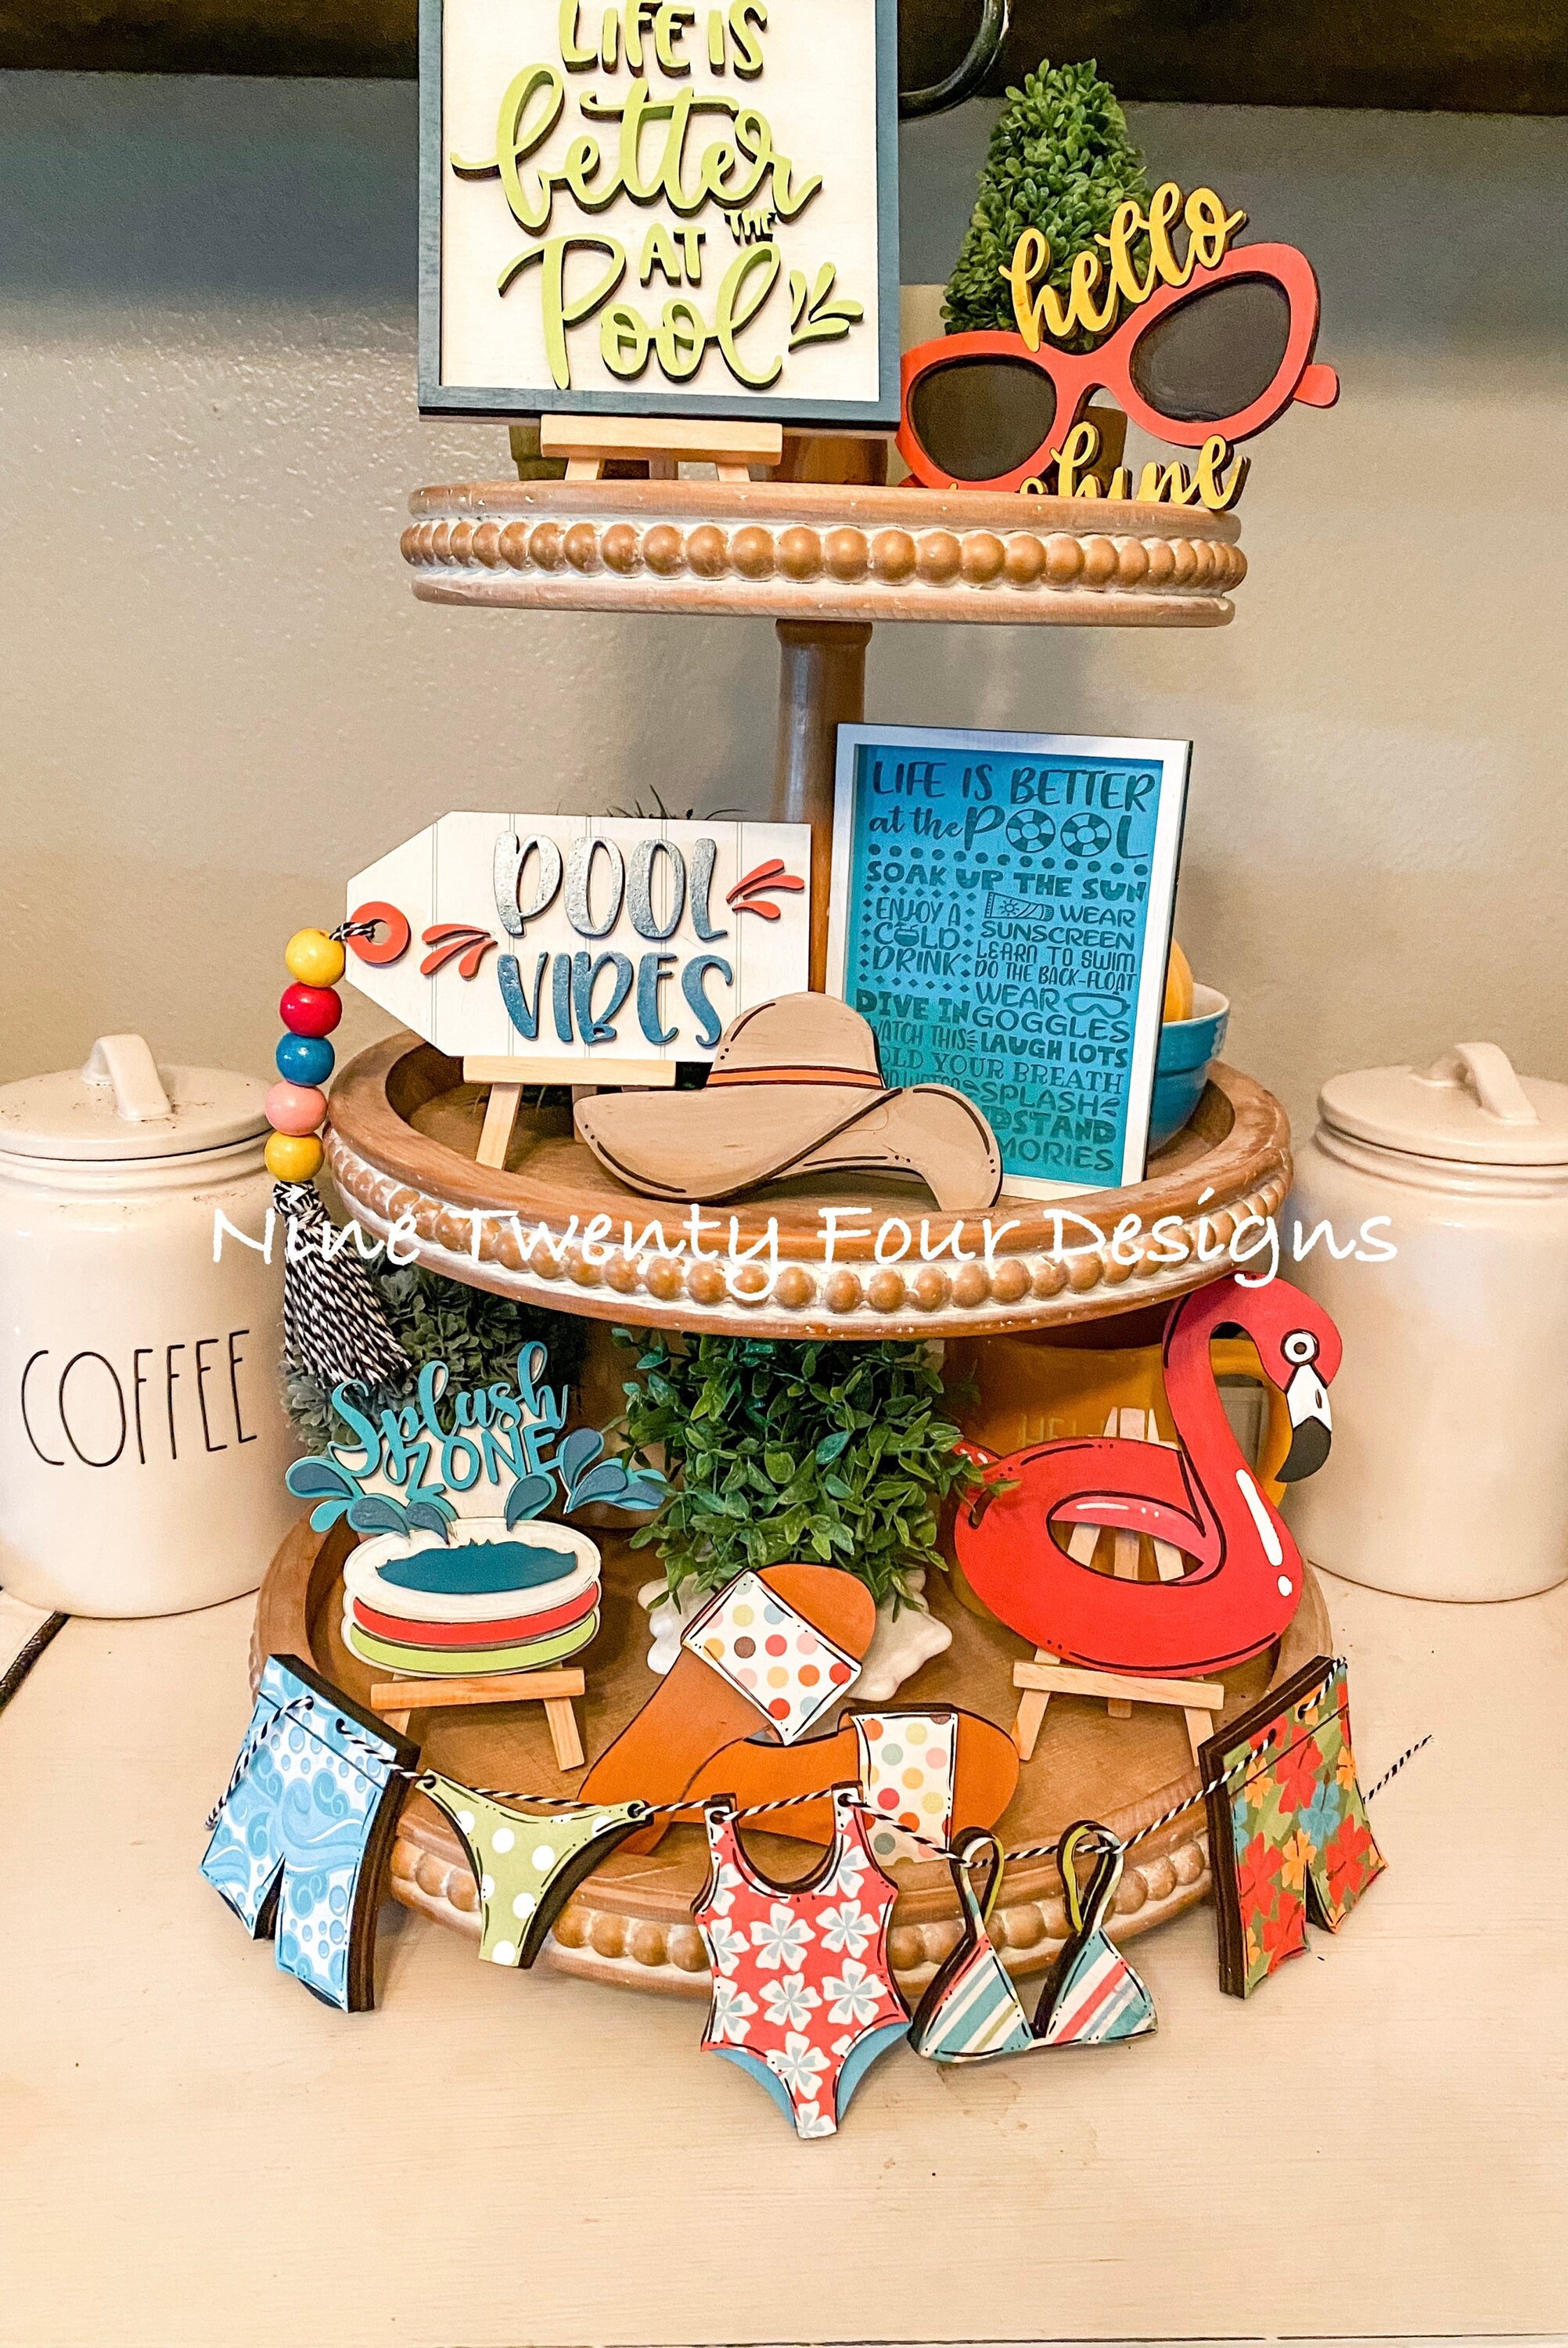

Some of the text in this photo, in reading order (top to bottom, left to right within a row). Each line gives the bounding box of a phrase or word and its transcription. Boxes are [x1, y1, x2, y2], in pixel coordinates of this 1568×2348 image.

[559, 0, 768, 81] LIFE IS
[450, 63, 823, 235] better
[640, 207, 776, 286] AT THE
[998, 182, 1249, 352] hello
[497, 233, 783, 391] Pool
[872, 760, 1156, 812] LIFE IS BETTER
[869, 805, 1149, 859] at the POOL
[493, 830, 728, 942] POOL
[866, 860, 1147, 903] SOAK UP THE SUN
[876, 896, 962, 927] ENJOY A
[1059, 904, 1136, 929] WEAR
[976, 939, 1135, 973] LEARN TO SWIM
[980, 920, 1135, 952] SUNSCREEN
[872, 945, 962, 977] DRINK
[974, 959, 1138, 992] DO THE BACK-FLOAT
[497, 950, 735, 1049] VIBES
[856, 987, 971, 1025] DIVE IN
[975, 981, 1061, 1014] WEAR
[930, 1024, 967, 1051] THIS
[972, 1006, 1131, 1044] GOGGLES
[880, 1045, 924, 1070] OLD
[930, 1051, 1005, 1080] YOUR
[1012, 1061, 1125, 1095] BREATH
[980, 1031, 1129, 1069] LAUGH LOTS
[979, 1081, 1099, 1118] SPLASH
[982, 1104, 1117, 1145] DSTAND
[998, 1136, 1115, 1172] MORIES
[20, 1328, 258, 1468] COFFEE
[327, 1341, 570, 1485] Splash
[405, 1420, 560, 1500] ZONE
